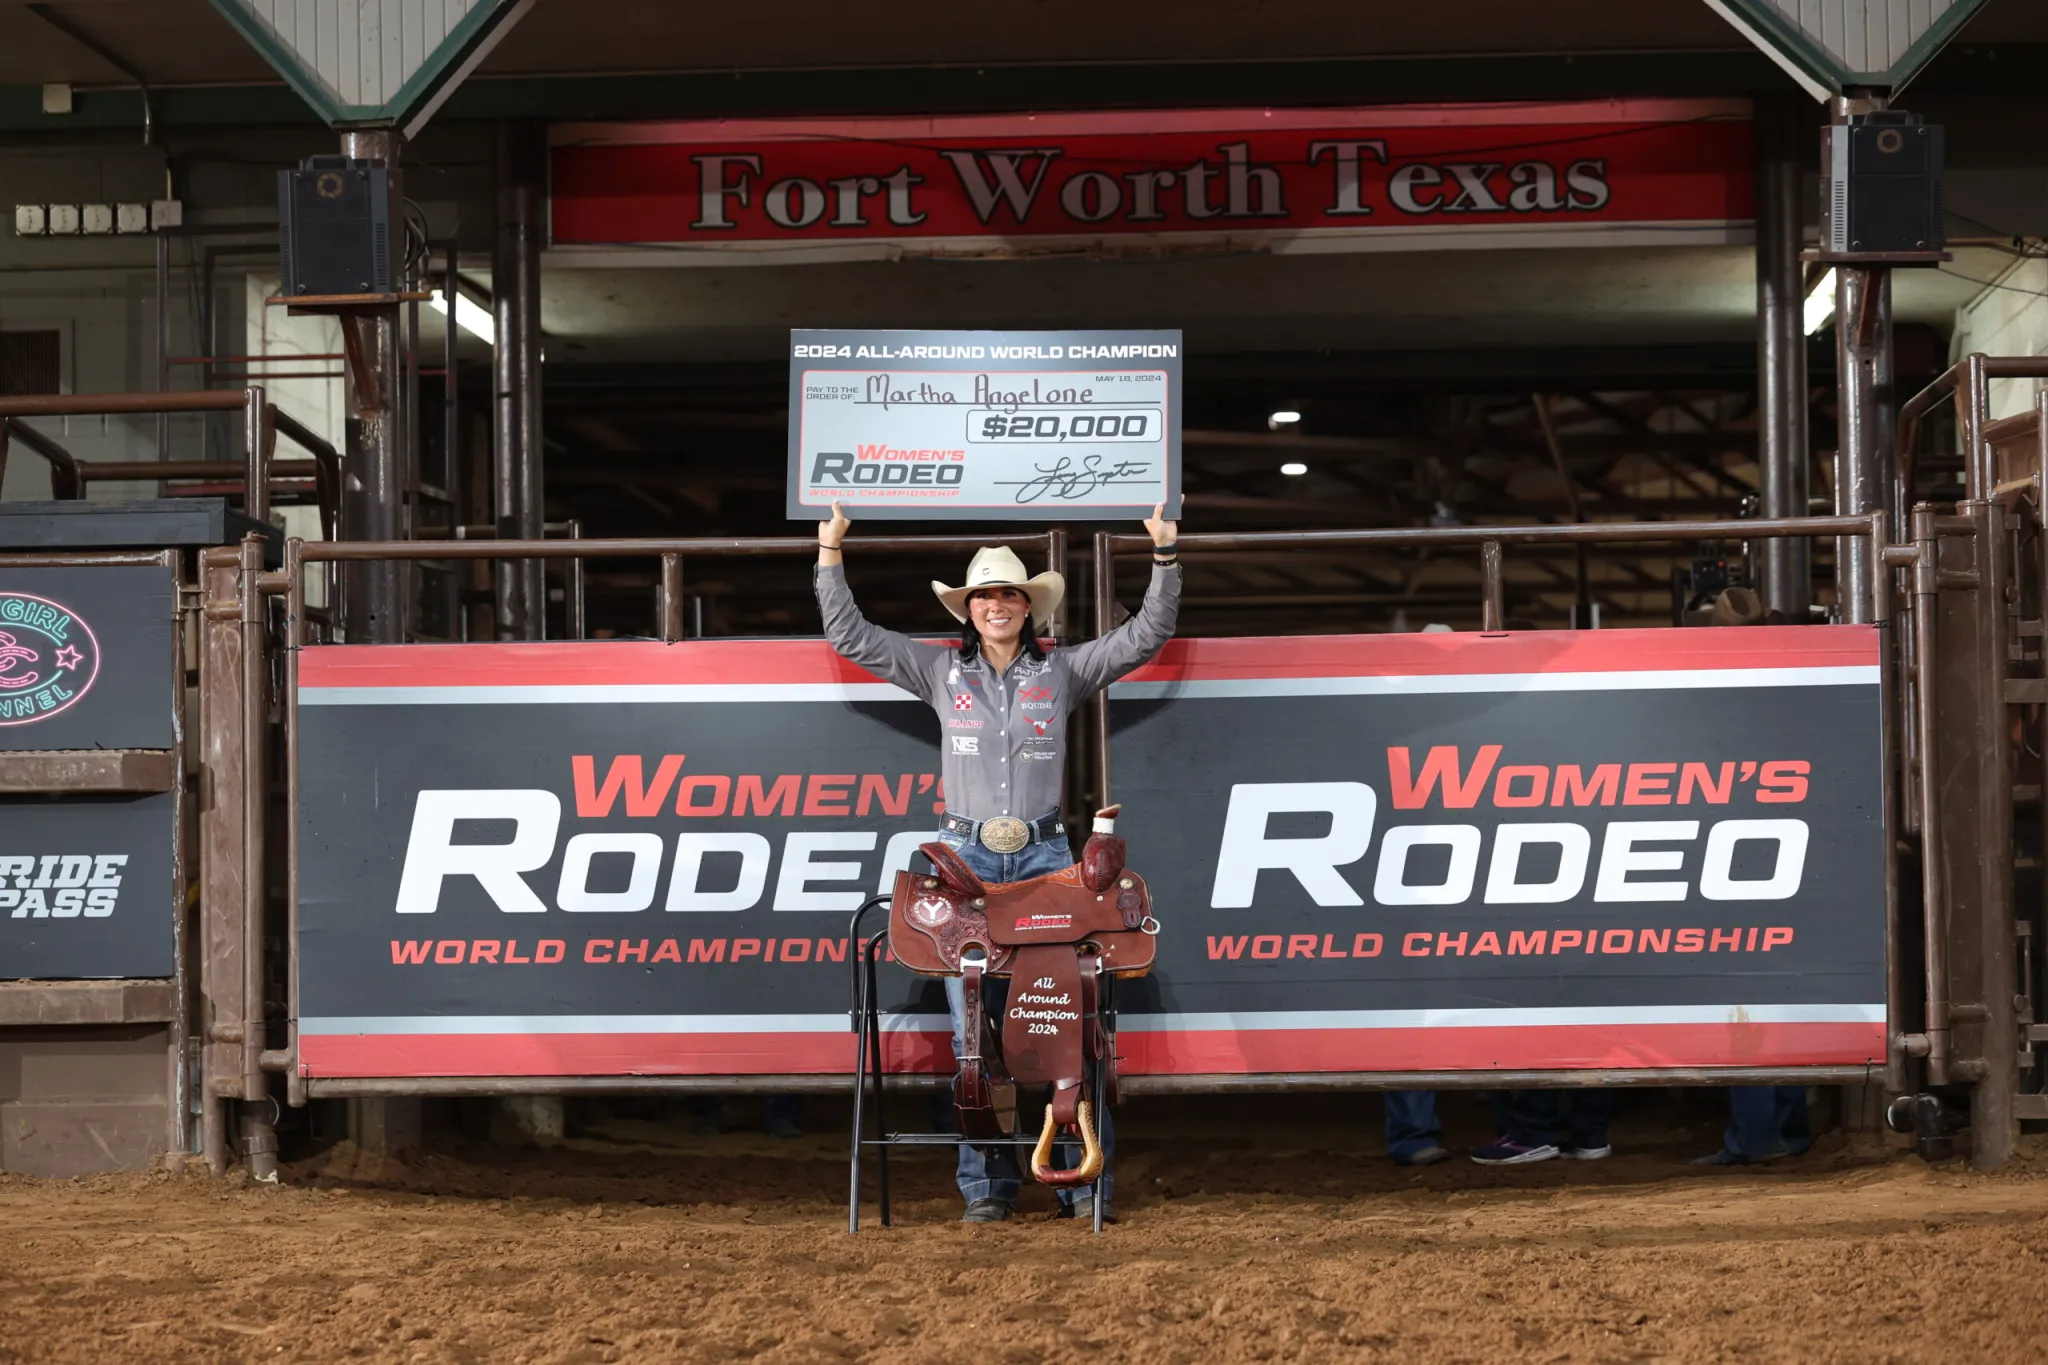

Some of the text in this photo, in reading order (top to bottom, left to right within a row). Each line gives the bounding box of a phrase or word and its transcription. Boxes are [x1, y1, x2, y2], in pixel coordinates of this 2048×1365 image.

[690, 138, 1611, 229] Fort Worth Texas
[794, 345, 1177, 359] 2024 ALL-AROUND WORLD CHAMPION
[806, 386, 824, 394] PAY
[1095, 375, 1162, 384] MAY 18, 2024
[840, 393, 856, 401] OF:
[866, 373, 1093, 415] Martha Angelone
[982, 414, 1148, 442] $20,000
[857, 444, 965, 461] WOMEN'S
[810, 452, 965, 485] RODEO
[808, 489, 960, 497] WORLD CHAMPIONSHIP
[0, 599, 70, 640] GIRL
[1021, 702, 1053, 710] EQUINE
[1386, 744, 1811, 809] WOMEN'S
[1210, 781, 1810, 909] RODEO
[0, 855, 129, 888] RIDE
[0, 888, 119, 918] PASS
[390, 937, 895, 965] WORLD CHAMPIONS
[1205, 926, 1794, 961] WORLD CHAMPIONSHIP
[1033, 976, 1056, 989] All
[1017, 992, 1072, 1005] Around
[1009, 1006, 1079, 1023] Champion
[1027, 1023, 1059, 1035] 2024
